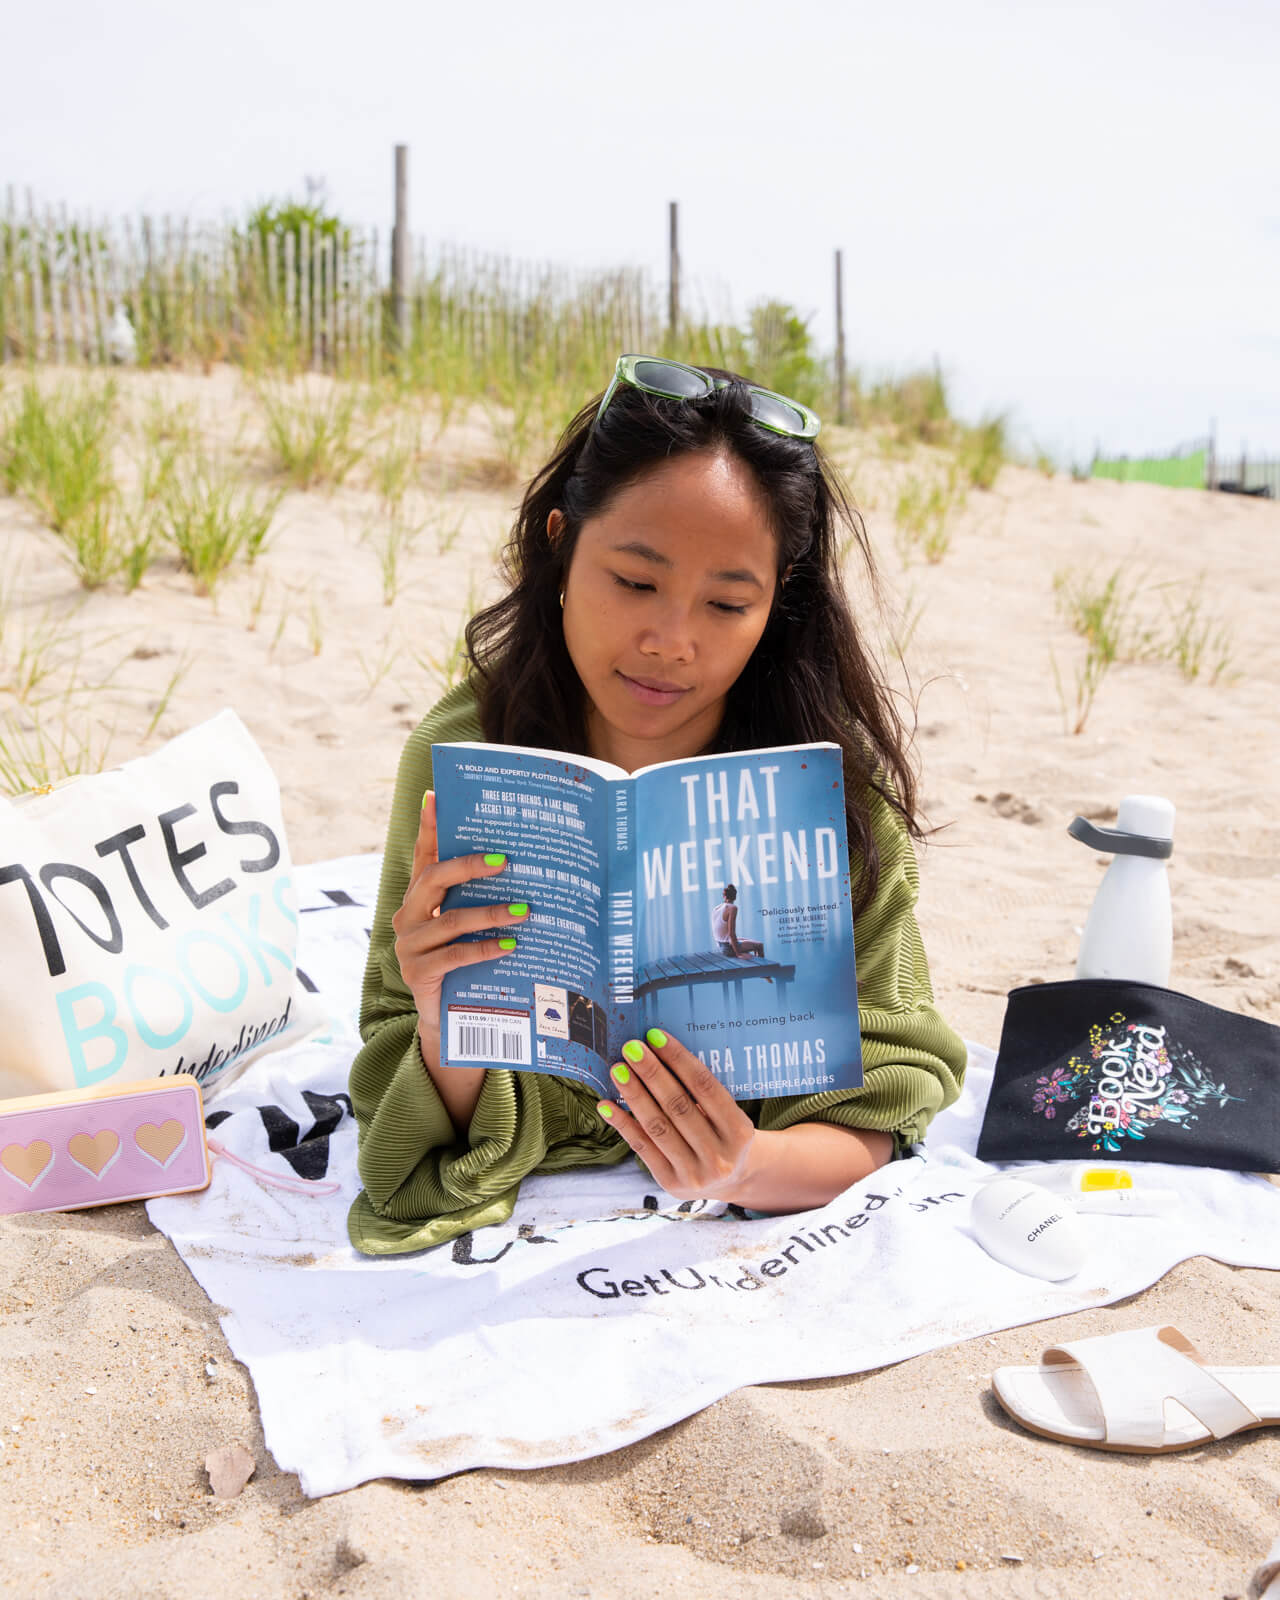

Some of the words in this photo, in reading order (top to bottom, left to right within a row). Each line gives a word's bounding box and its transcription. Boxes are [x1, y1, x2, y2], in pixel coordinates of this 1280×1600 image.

[501, 769, 530, 778] EXPERTLY
[532, 771, 558, 782] PLOTTED
[480, 803, 502, 815] SECRET
[539, 811, 557, 824] COULD
[481, 789, 500, 801] THREE
[501, 791, 516, 803] BEST
[549, 799, 562, 811] LAKE
[615, 788, 627, 813] KARA
[681, 765, 780, 826] THAT
[615, 815, 628, 852] THOMAS
[0, 781, 281, 977] TOTES
[546, 868, 556, 881] BUT
[643, 827, 839, 901] WEEKEND
[612, 889, 633, 927] THAT
[56, 876, 297, 1090] BOOKS
[613, 933, 635, 1004] WEEKEND
[686, 1019, 727, 1033] There's
[728, 1021, 743, 1030] no
[745, 1015, 786, 1028] coming
[789, 1010, 816, 1023] back
[690, 1049, 736, 1074] ARA
[743, 1038, 827, 1071] THOMAS
[729, 1083, 751, 1093] THE
[753, 1074, 836, 1092] CHEERLEADERS
[1088, 1038, 1131, 1134] Book
[1121, 1025, 1166, 1113] Nerd
[1027, 1213, 1063, 1242] CHANEL
